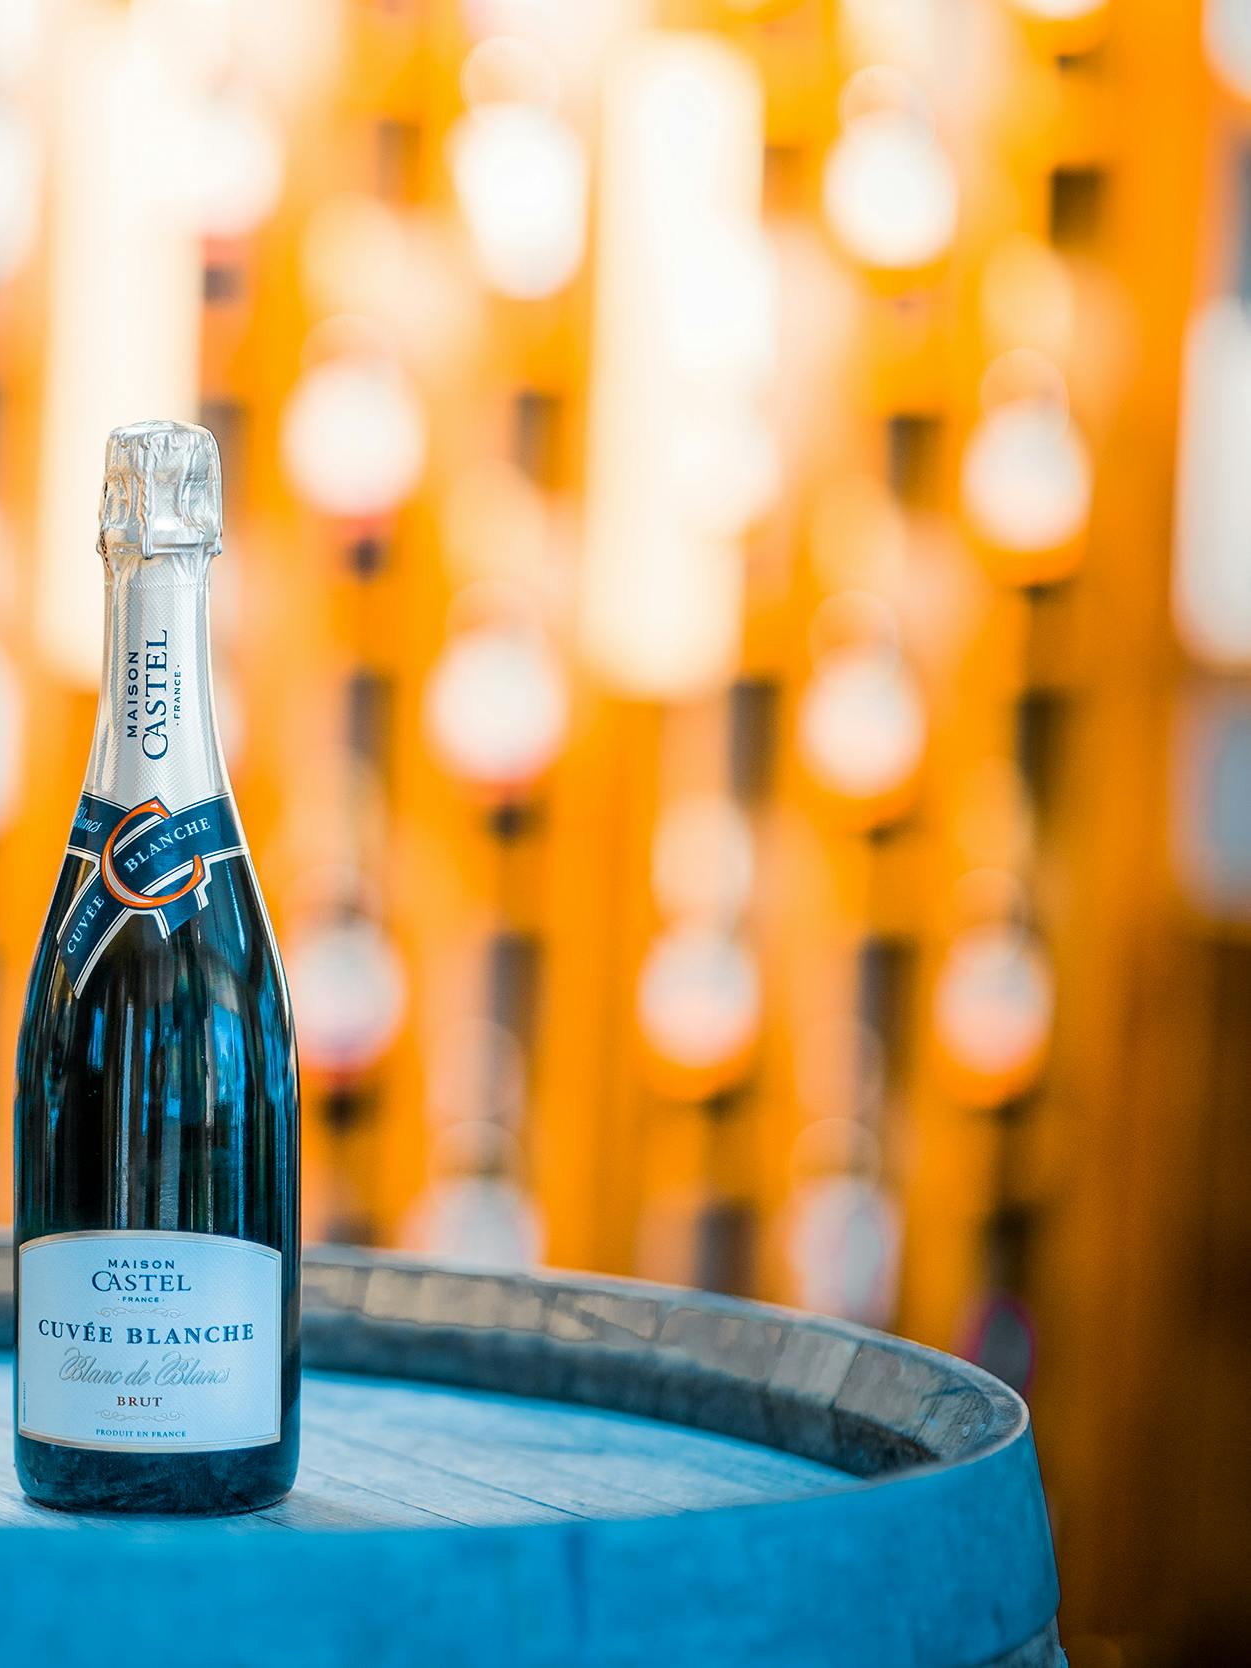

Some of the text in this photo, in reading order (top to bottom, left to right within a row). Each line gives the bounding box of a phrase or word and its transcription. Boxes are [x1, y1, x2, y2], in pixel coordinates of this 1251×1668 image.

[127, 651, 139, 738] MAISON
[141, 629, 169, 761] CASTEL
[173, 671, 182, 720] FRANCE
[66, 816, 211, 954] CUVÉE BLANCHE
[107, 1259, 175, 1270] MAISON
[91, 1270, 192, 1293] CASTEL
[38, 1319, 254, 1345] CUVÉE BLANCHE
[58, 1347, 231, 1387] Blanc de Blancs
[116, 1396, 163, 1408] BRUT
[95, 1428, 134, 1438] PRODUIT
[151, 1430, 187, 1438] FRANCE
